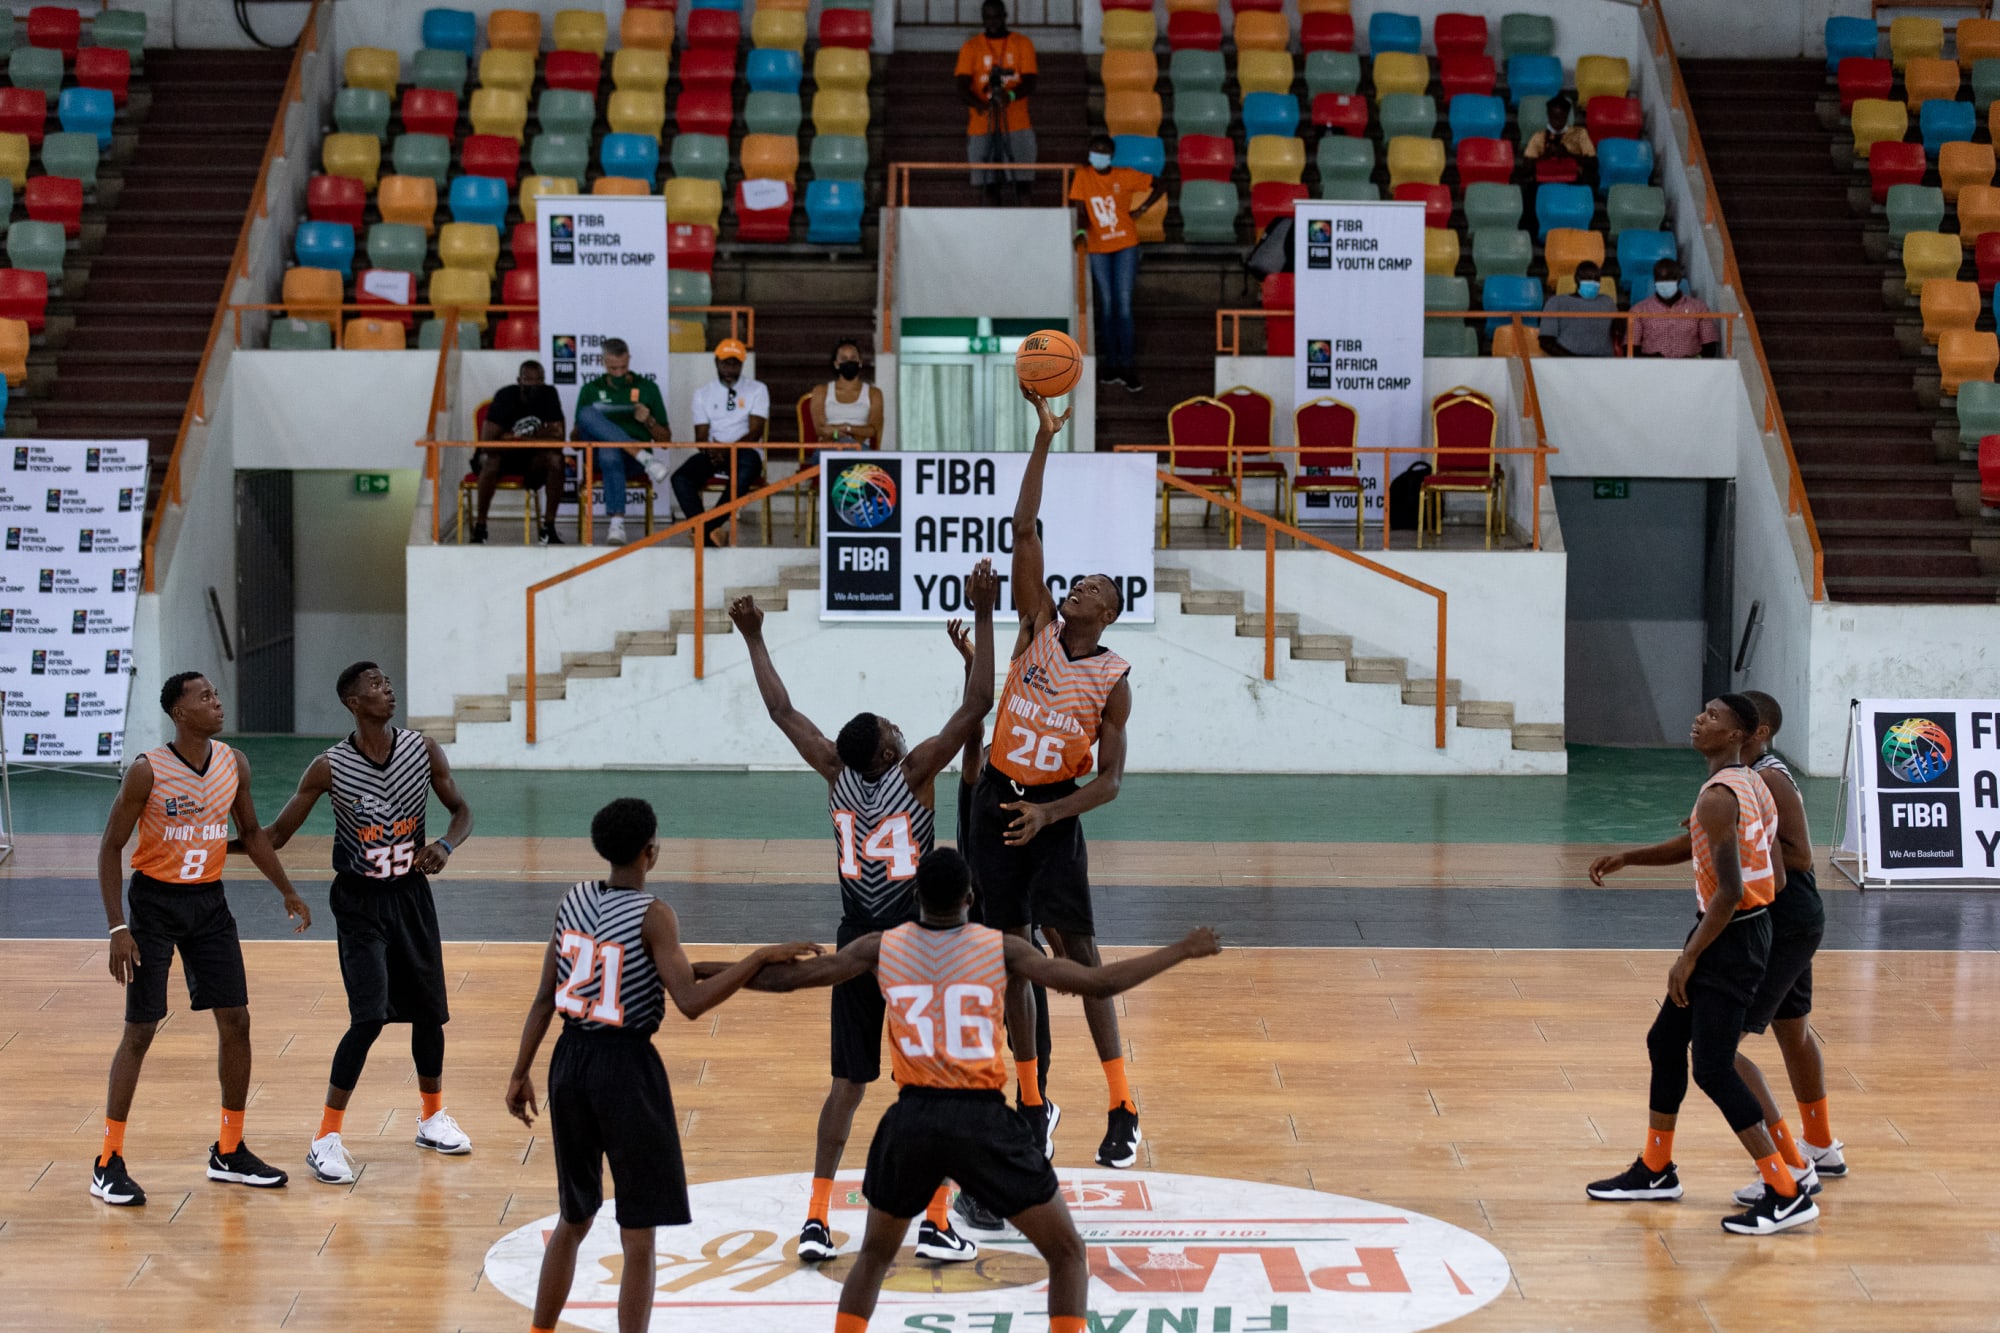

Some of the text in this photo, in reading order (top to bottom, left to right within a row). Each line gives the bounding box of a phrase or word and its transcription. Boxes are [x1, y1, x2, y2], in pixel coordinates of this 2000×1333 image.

[578, 214, 604, 226] FIBA
[1336, 220, 1362, 232] FIBA
[578, 233, 620, 246] AFRICA
[1336, 238, 1378, 250] AFRICA
[580, 253, 655, 265] YOUTH CAMP
[1336, 258, 1412, 270] YOUTH CAMP
[1336, 340, 1362, 352] FIBA
[1336, 358, 1378, 370] AFRICA
[1336, 378, 1411, 390] YOUTH CAMP
[916, 458, 995, 495] FIBA
[1334, 496, 1372, 508] YOUH
[915, 516, 1043, 552] AFRIC
[839, 547, 890, 572] FIBA
[1007, 694, 1041, 721] IVORY
[1006, 725, 1066, 772] 26
[1892, 802, 1948, 828] FIBA
[163, 824, 228, 841] IVORY COAS
[832, 810, 920, 881] 14
[1889, 850, 1903, 858] We
[1918, 850, 1954, 858] Basketball
[180, 849, 208, 880] 8
[365, 840, 414, 879] 35
[554, 929, 624, 1027] 21
[886, 983, 996, 1060] 36
[904, 1305, 1288, 1333] FINAES
